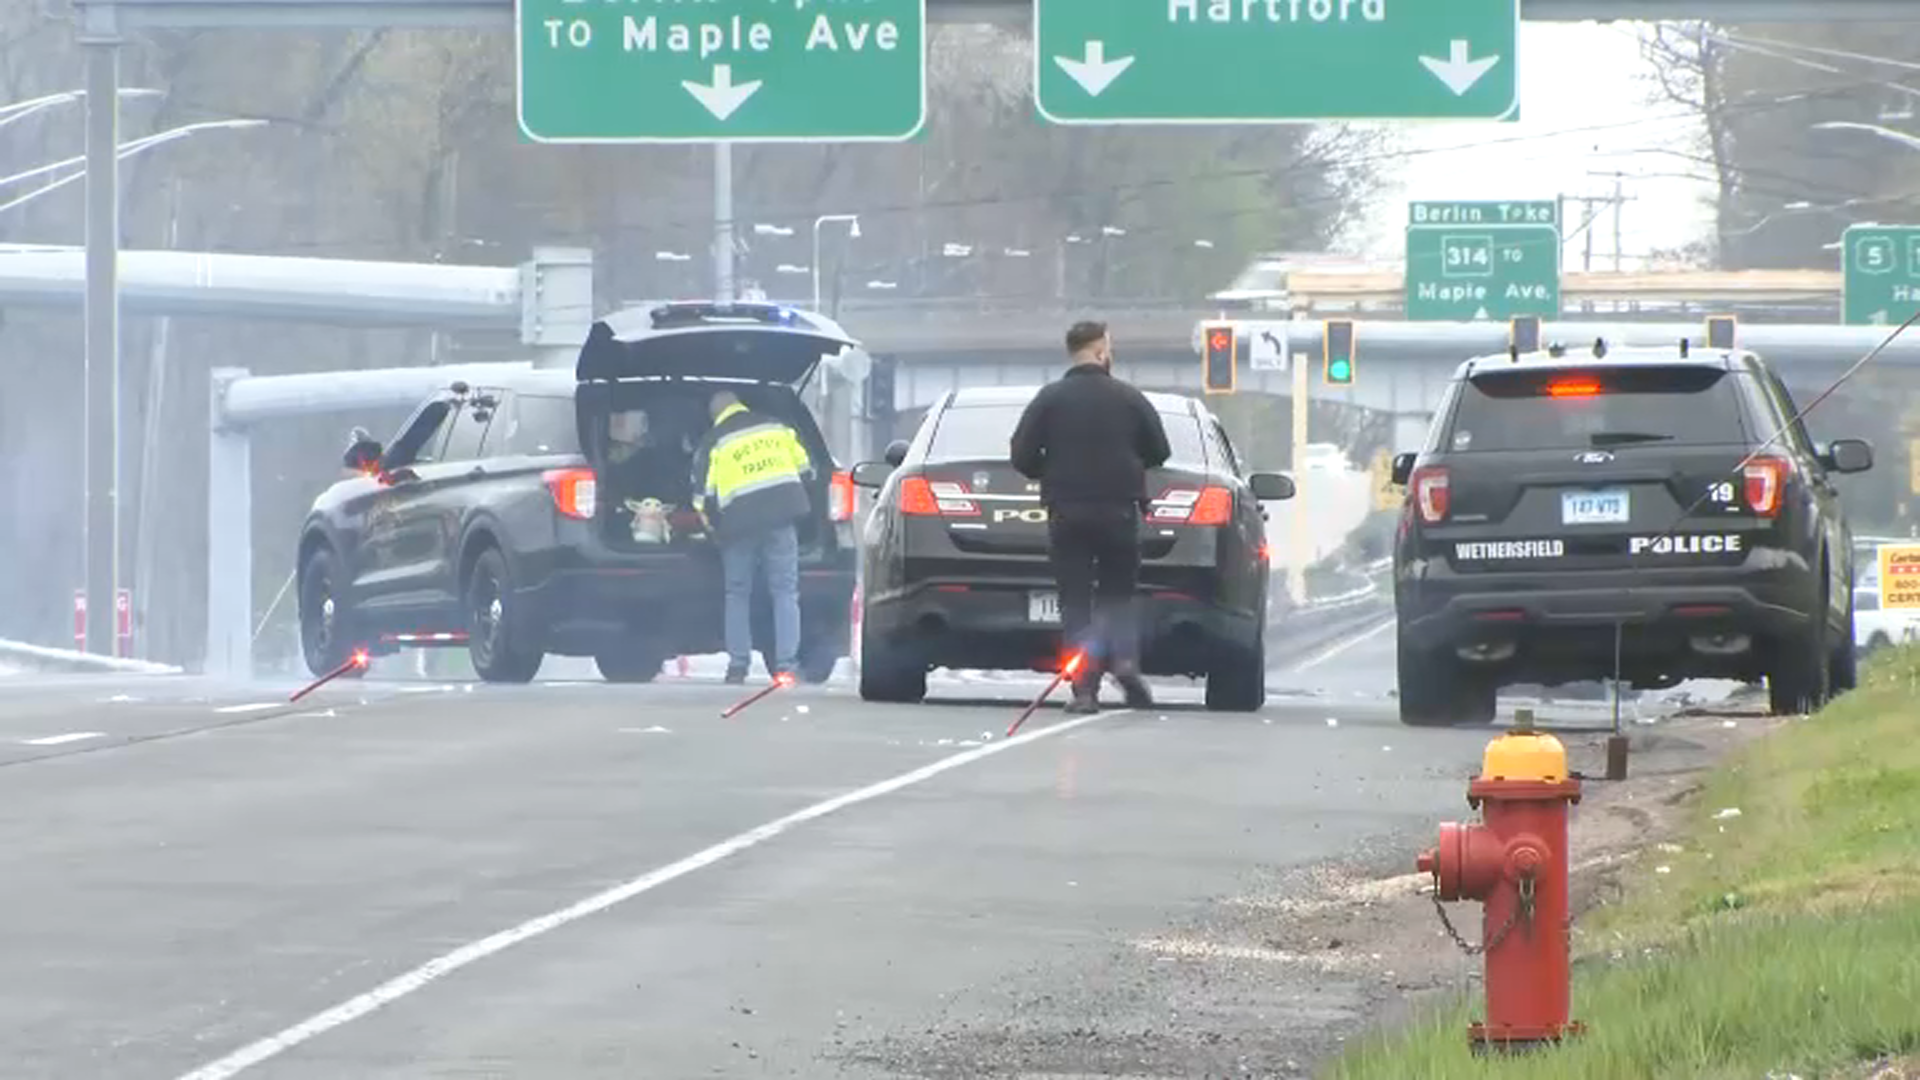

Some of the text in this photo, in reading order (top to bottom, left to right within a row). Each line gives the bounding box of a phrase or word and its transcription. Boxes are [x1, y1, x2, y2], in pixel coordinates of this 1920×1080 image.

[544, 14, 898, 58] TO Maple Ave
[1414, 204, 1482, 222] Berlin
[1447, 247, 1523, 265] 314 TO
[1868, 247, 1882, 265] 5
[1417, 283, 1487, 302] Maple
[1708, 483, 1734, 501] 19
[1455, 540, 1564, 560] WETHERSFIELD
[1629, 535, 1741, 554] POLICE
